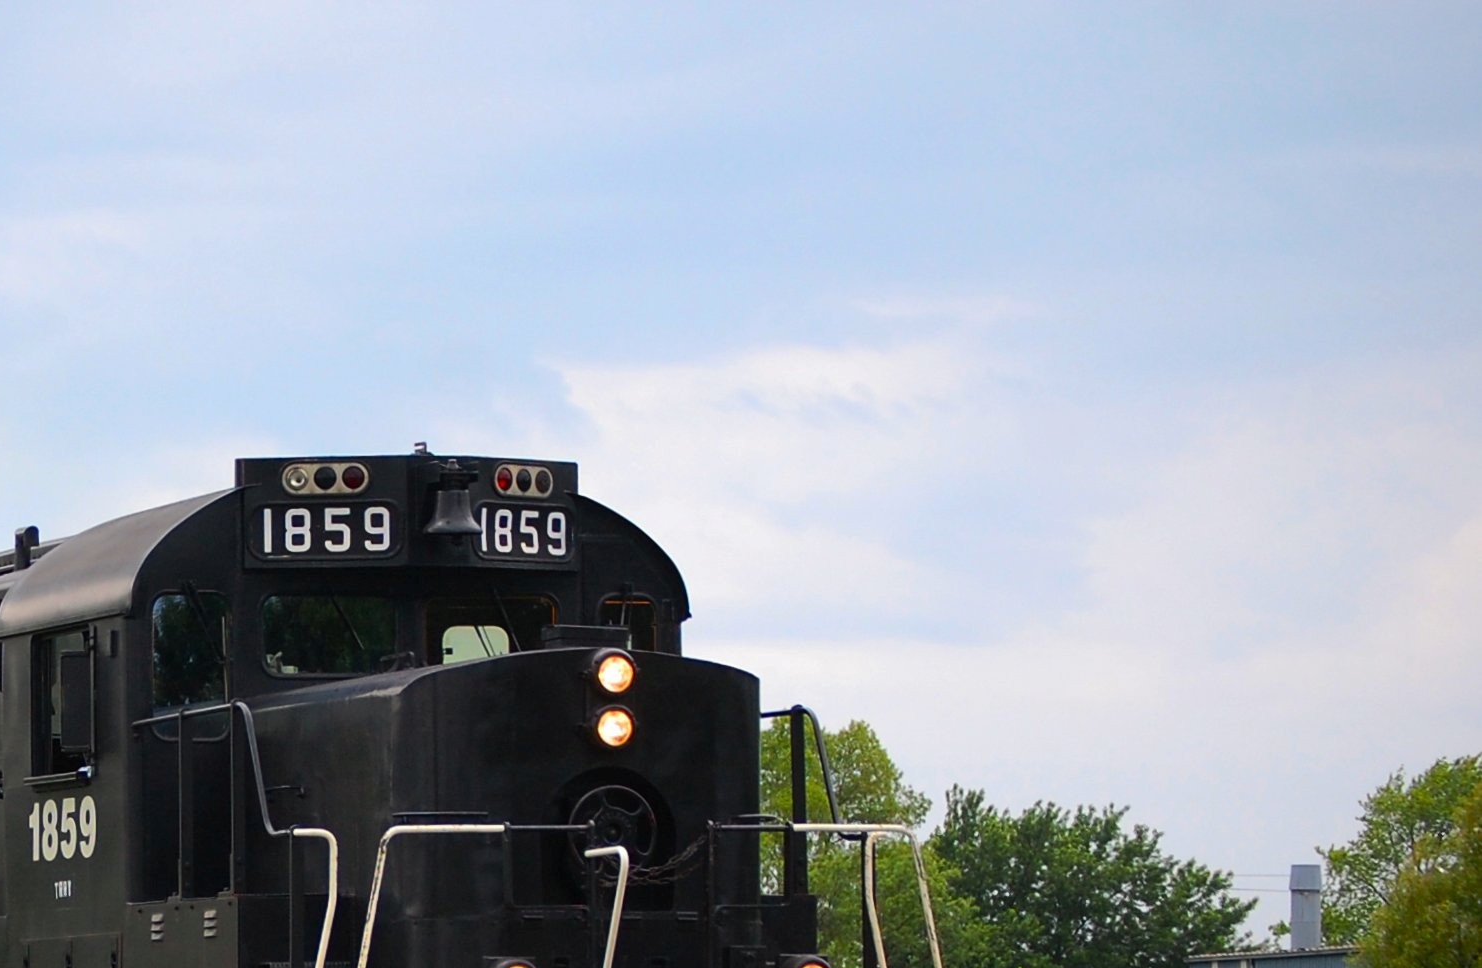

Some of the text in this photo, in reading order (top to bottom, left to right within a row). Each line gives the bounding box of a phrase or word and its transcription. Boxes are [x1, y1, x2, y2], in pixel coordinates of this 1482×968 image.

[263, 506, 391, 553] 1859
[480, 508, 567, 556] 1859
[29, 795, 97, 862] 1859
